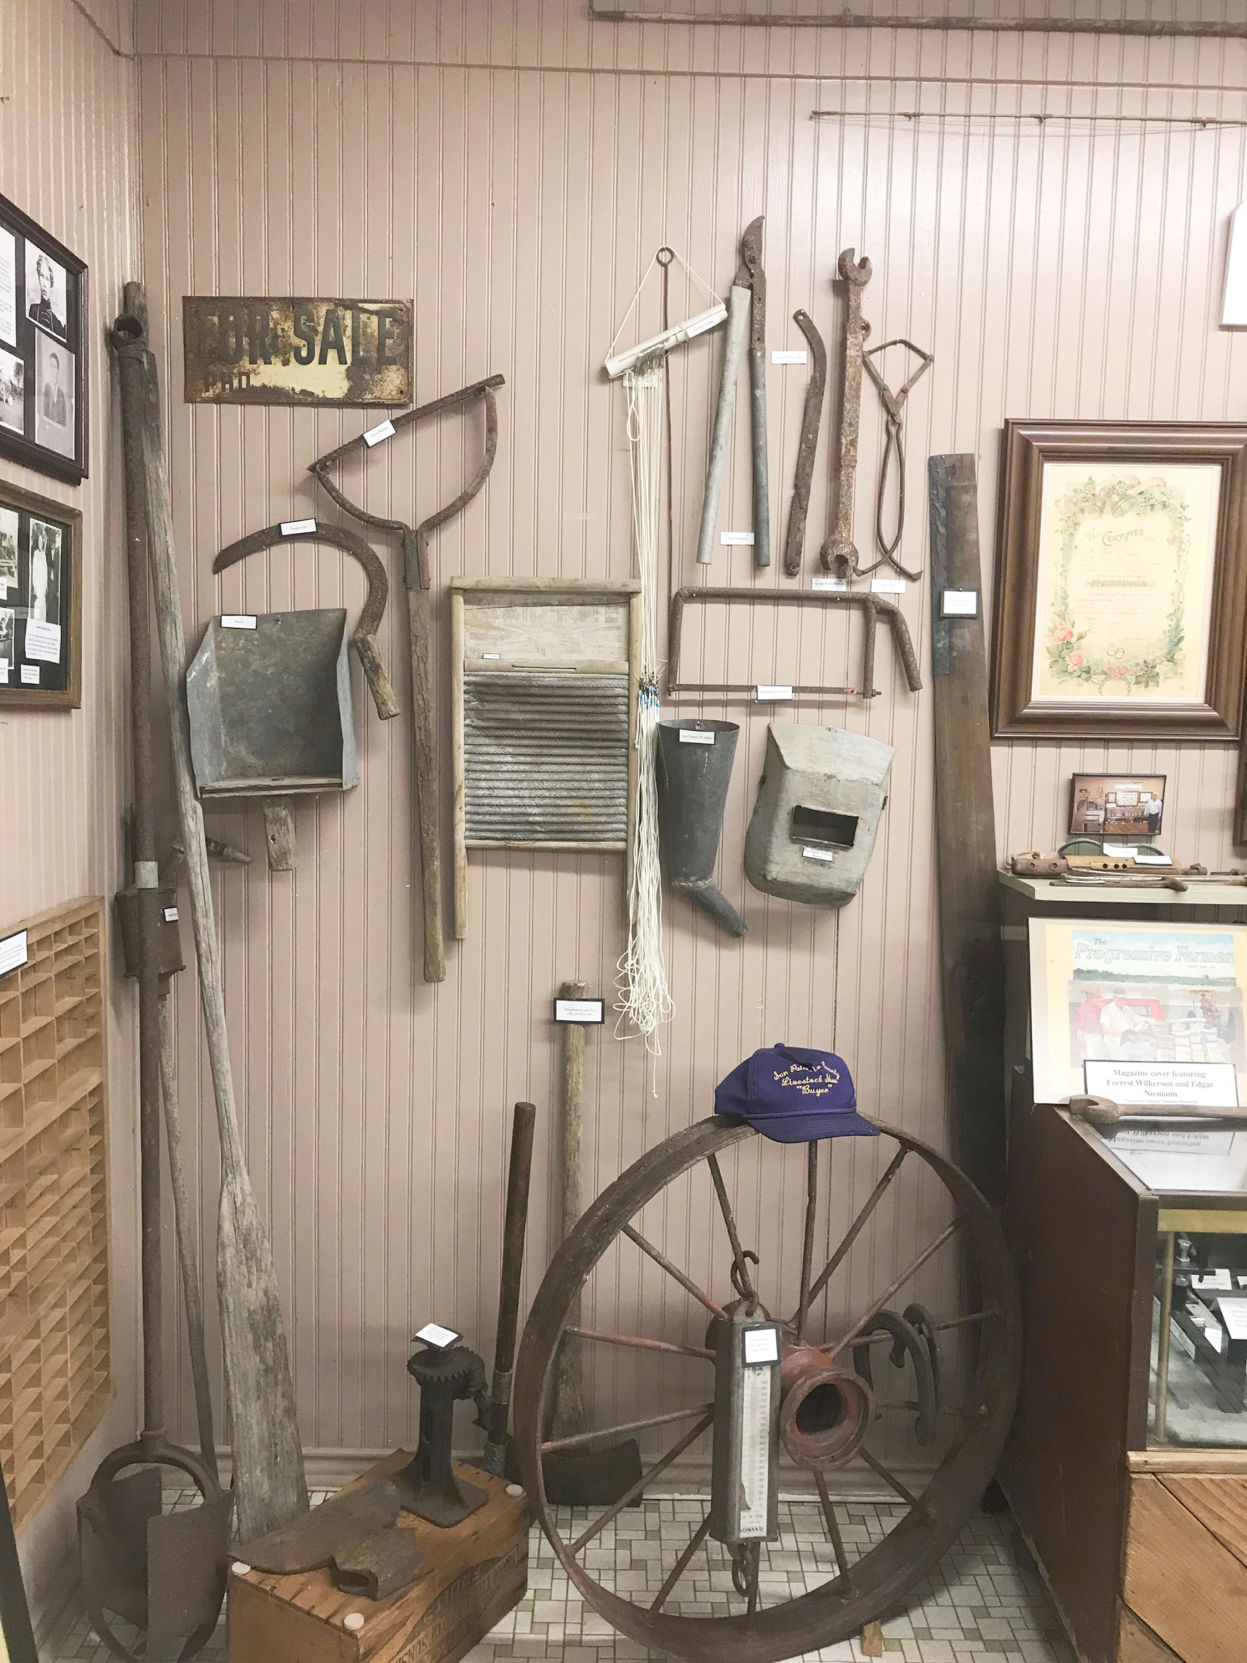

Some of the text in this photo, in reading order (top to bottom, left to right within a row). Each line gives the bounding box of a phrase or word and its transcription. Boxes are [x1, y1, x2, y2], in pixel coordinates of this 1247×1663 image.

[294, 308, 400, 366] SALE
[1093, 937, 1107, 945] The
[1073, 942, 1235, 964] Progressive Farmer
[1112, 1069, 1148, 1078] Magazine
[1172, 1069, 1206, 1079] featuring
[781, 1074, 823, 1086] Livestock
[1106, 1079, 1133, 1087] Forrest
[1135, 1079, 1173, 1087] Wilkerson
[1191, 1081, 1213, 1089] Edgar
[1144, 1089, 1178, 1098] Niemann
